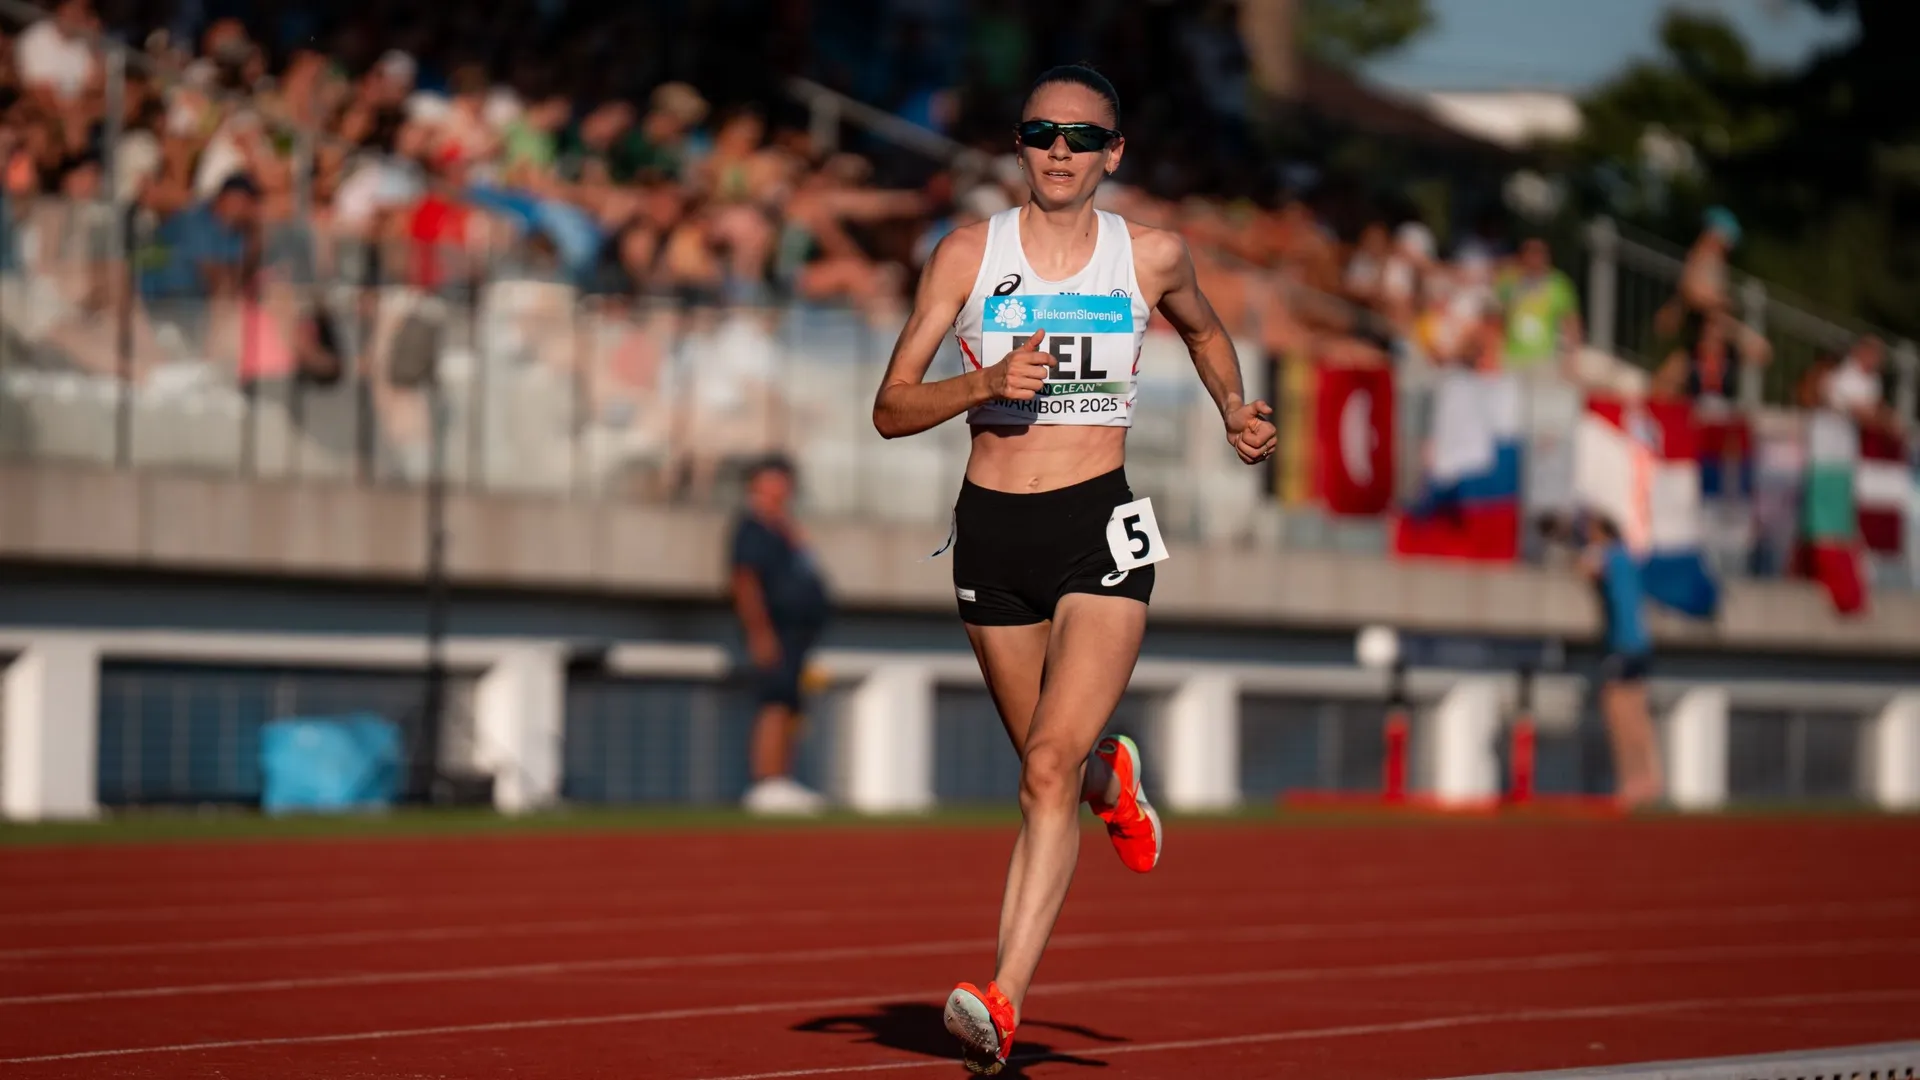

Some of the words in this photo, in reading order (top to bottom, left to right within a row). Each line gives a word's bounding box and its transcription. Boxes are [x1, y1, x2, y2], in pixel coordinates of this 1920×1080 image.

[1032, 308, 1123, 323] TelekomSlovenije
[1013, 336, 1107, 379] EL
[1080, 398, 1118, 412] 2025
[1123, 514, 1150, 559] 5
